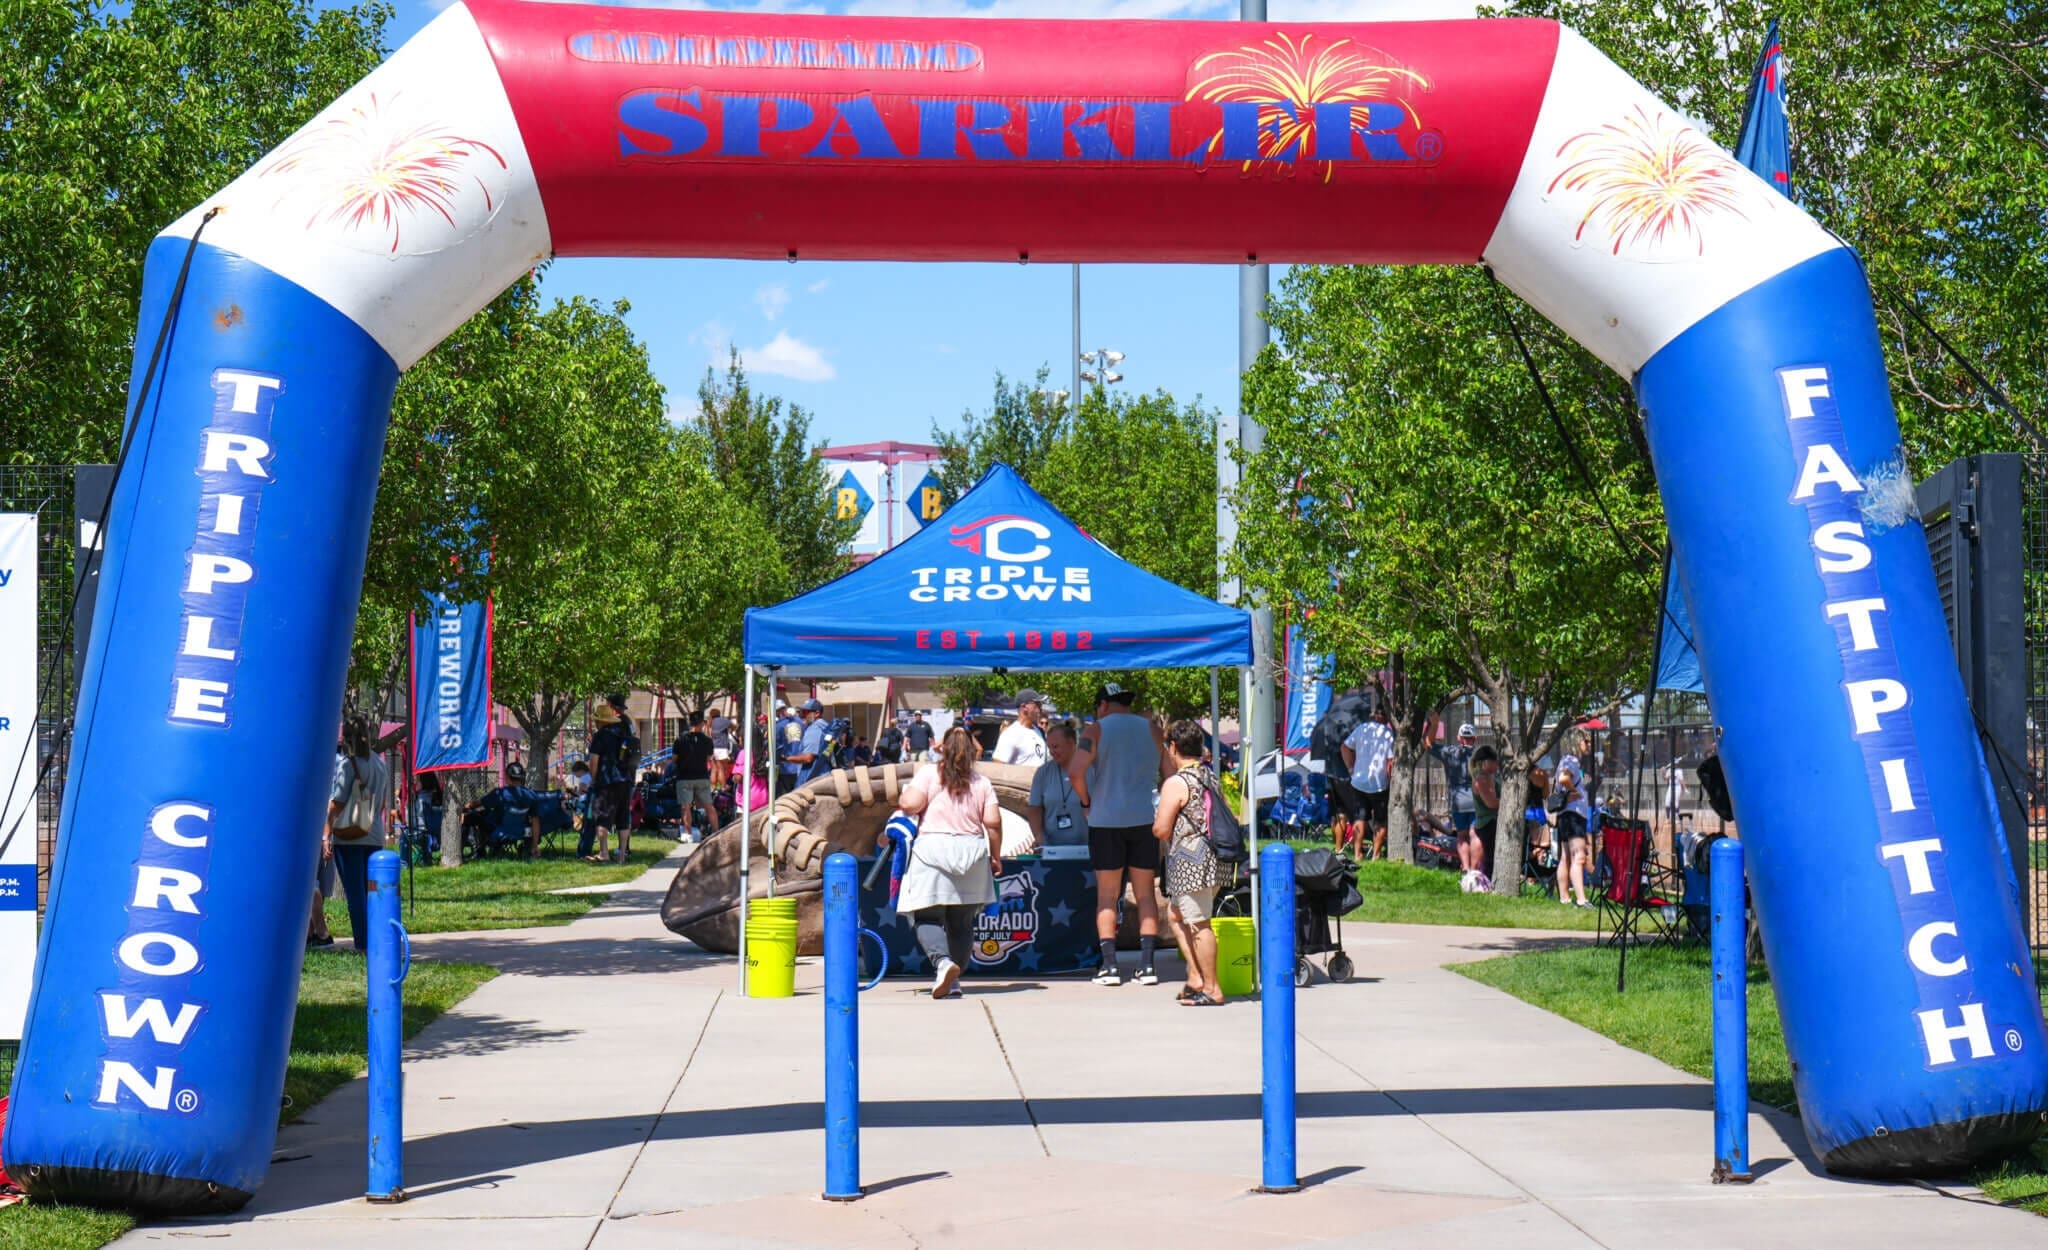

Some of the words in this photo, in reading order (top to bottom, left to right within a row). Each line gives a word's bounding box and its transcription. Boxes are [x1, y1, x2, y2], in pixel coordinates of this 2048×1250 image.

[568, 33, 977, 69] COLORADO
[617, 91, 1416, 164] SPARKLER
[837, 488, 858, 520] B
[922, 487, 942, 520] B
[172, 371, 281, 726] TRIPLE
[911, 565, 1090, 586] TRIPLE
[909, 584, 1092, 603] CROWN
[916, 630, 982, 649] EST
[1005, 631, 1093, 650] 1982
[439, 591, 462, 750] IREWORKS
[1782, 368, 1995, 1065] FASTPITCH
[973, 912, 1033, 931] ORADO
[979, 931, 990, 941] OF
[990, 931, 1011, 941] JULY
[97, 804, 209, 1110] CROWN
